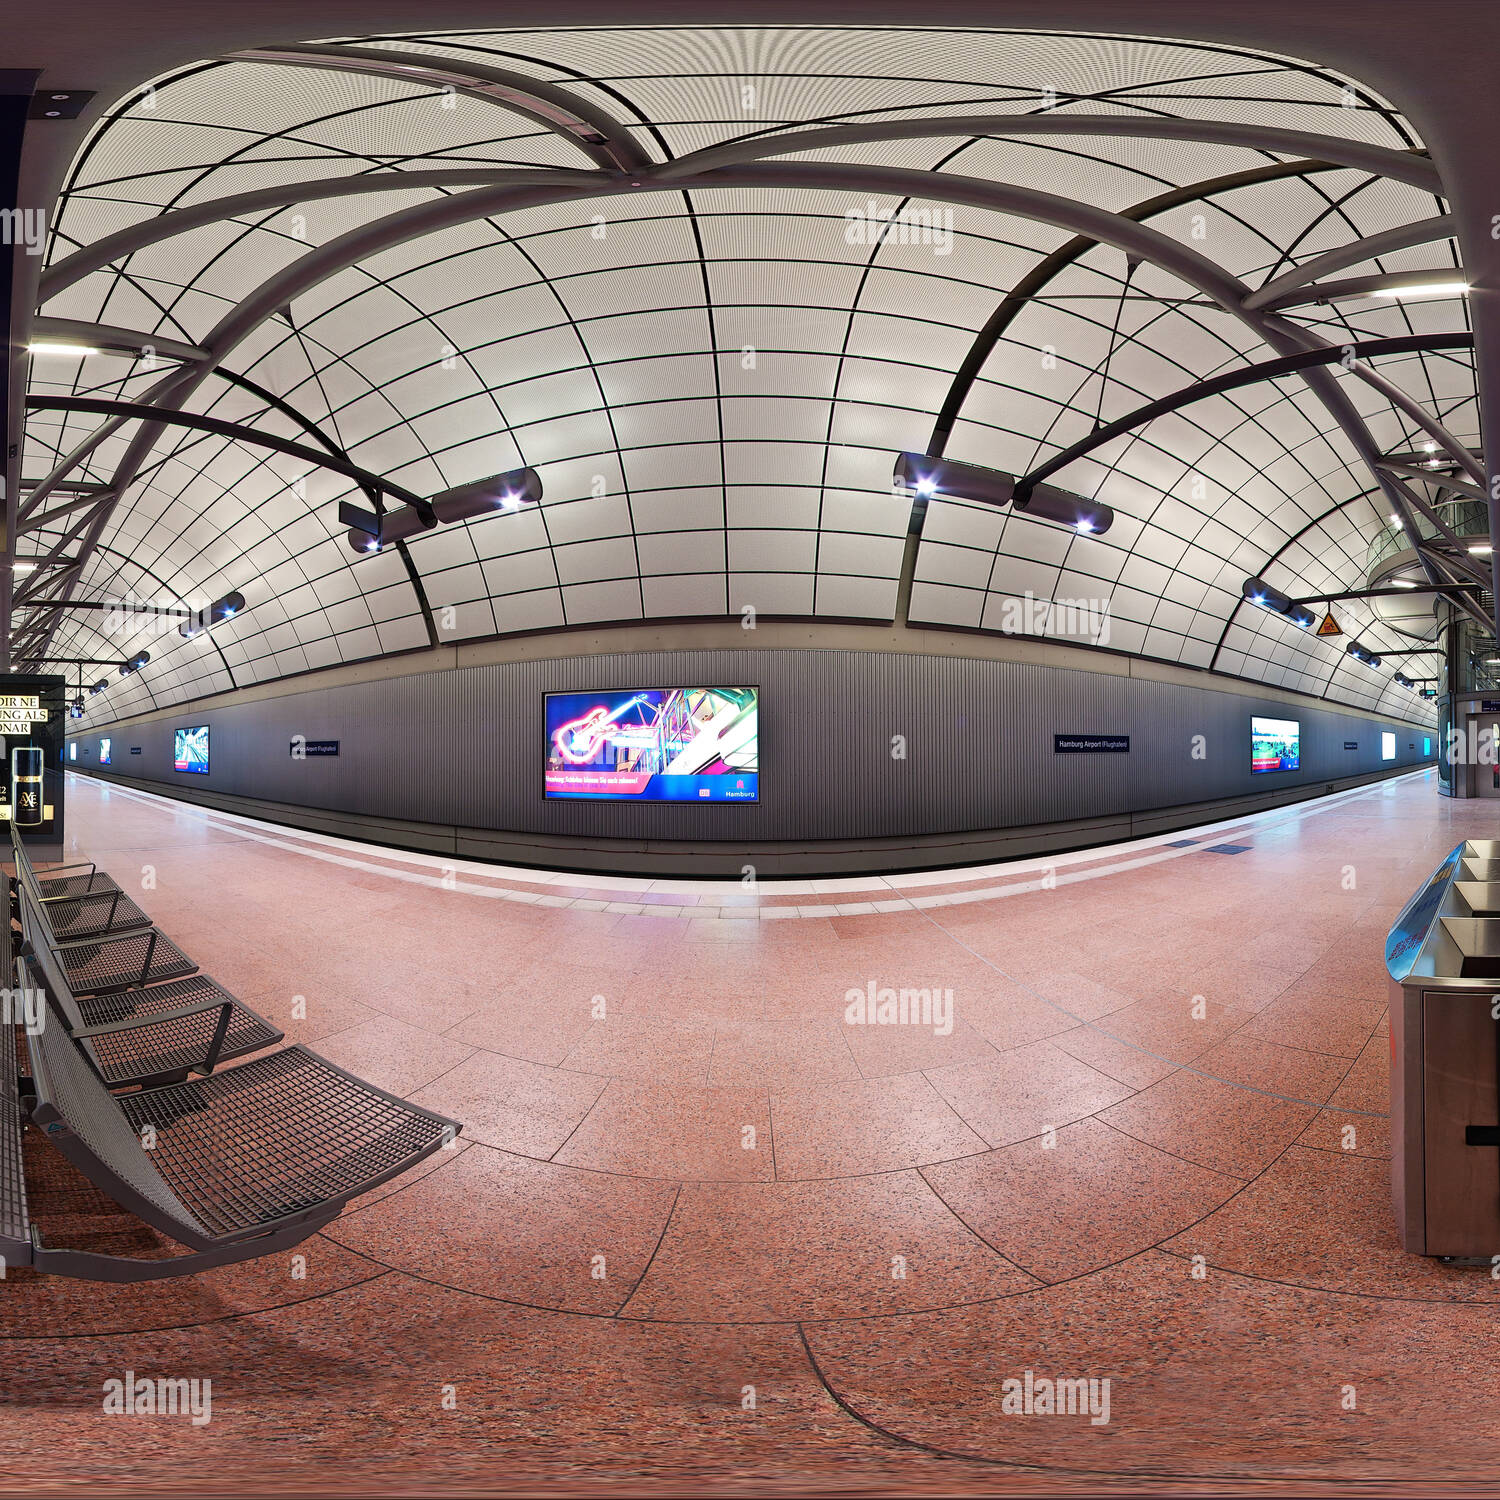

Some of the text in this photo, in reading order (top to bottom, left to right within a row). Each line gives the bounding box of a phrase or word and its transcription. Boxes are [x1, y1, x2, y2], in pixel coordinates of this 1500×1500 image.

[20, 698, 37, 706] NE
[0, 711, 46, 720] NG ALS
[1059, 740, 1084, 748] Hamburg
[1084, 740, 1101, 748] Airport
[19, 792, 38, 807] AXE
